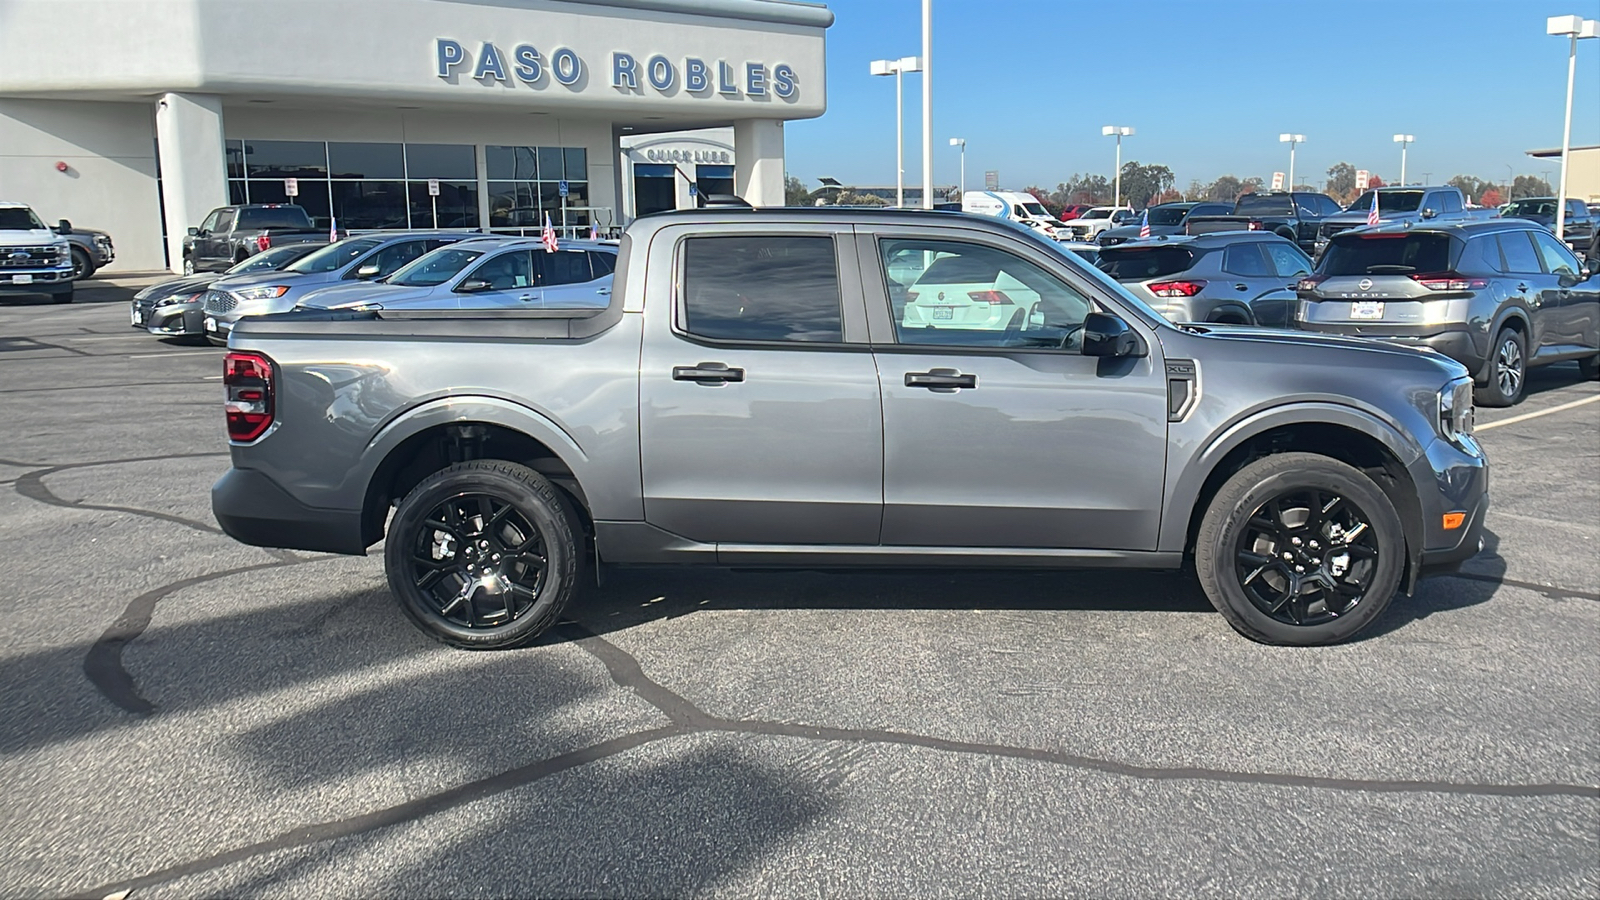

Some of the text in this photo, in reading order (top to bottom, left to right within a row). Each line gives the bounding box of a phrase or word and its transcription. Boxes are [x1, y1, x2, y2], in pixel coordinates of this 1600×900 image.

[435, 37, 796, 98] PASO ROBLES
[647, 149, 727, 162] QUICK LUBE
[1221, 494, 1254, 547] GOODYEAR
